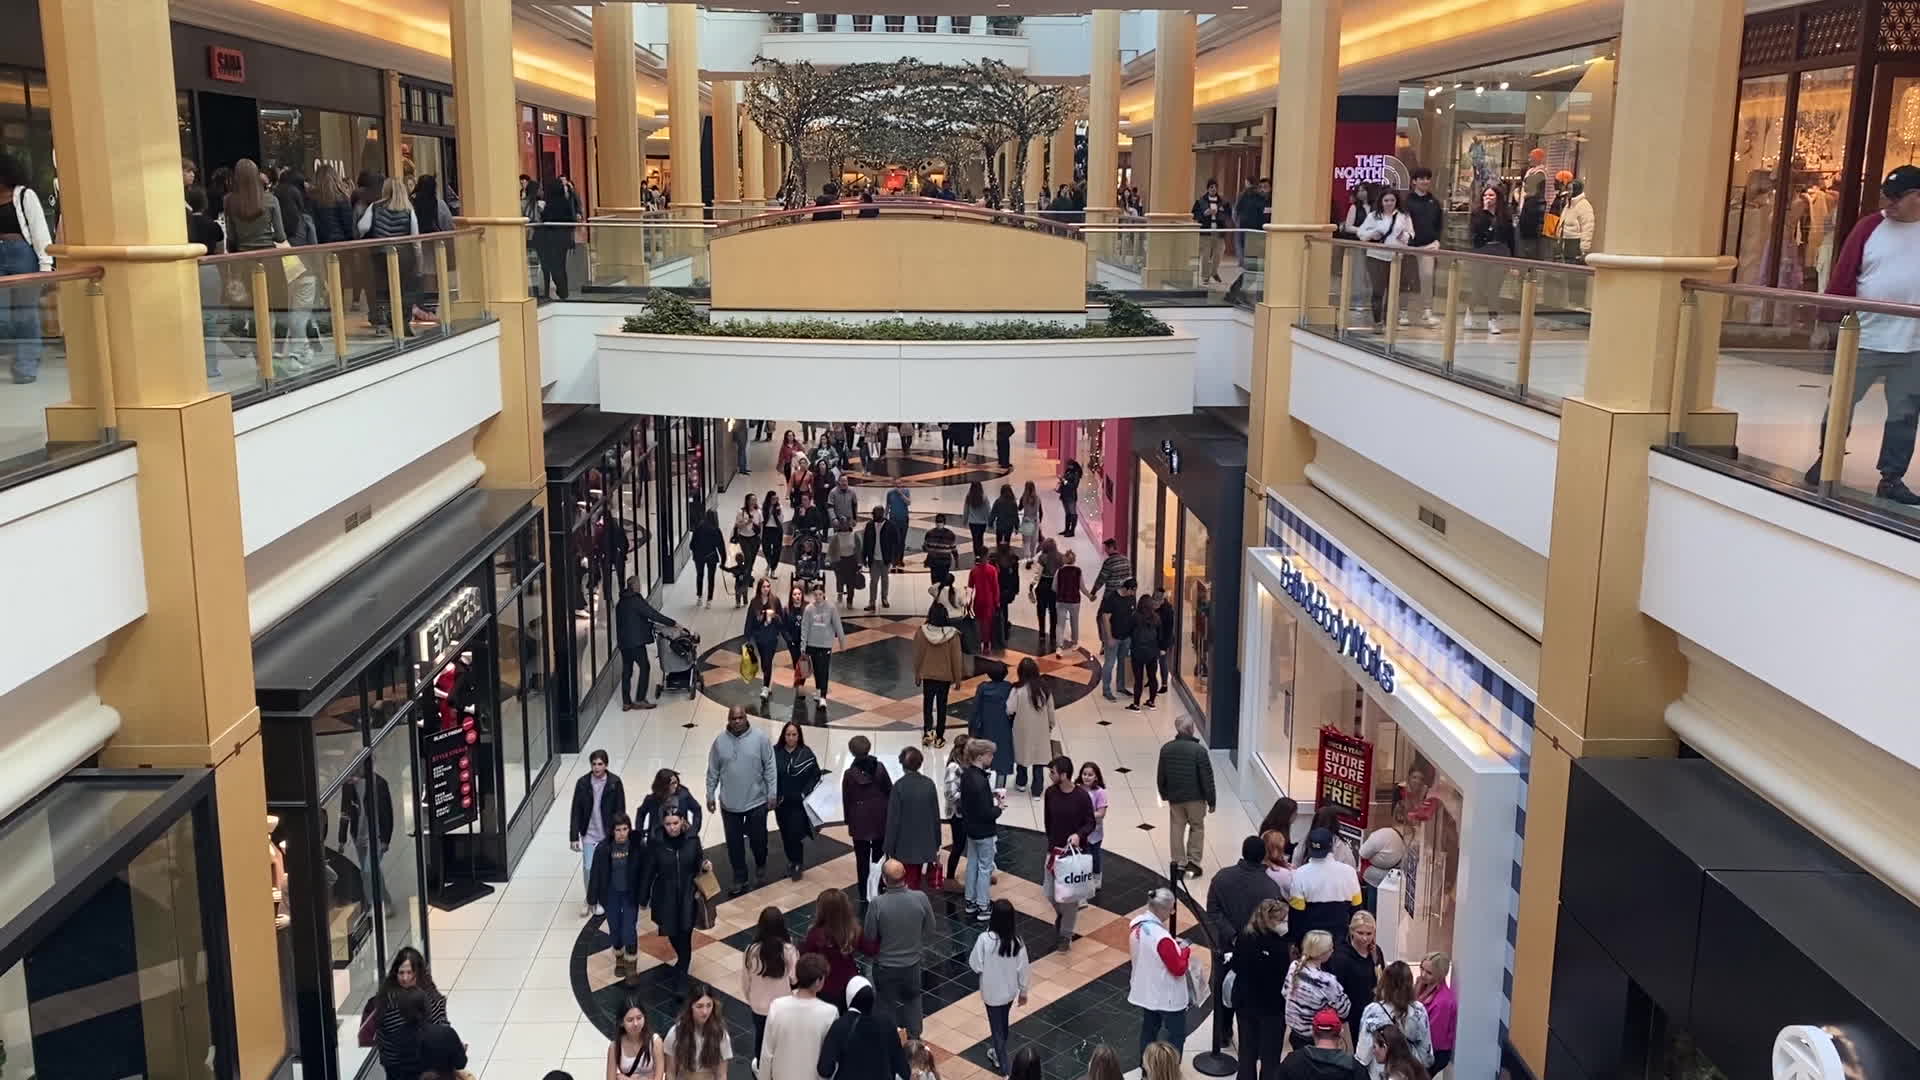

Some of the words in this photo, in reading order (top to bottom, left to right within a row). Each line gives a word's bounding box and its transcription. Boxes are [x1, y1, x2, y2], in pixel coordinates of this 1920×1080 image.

[1355, 154, 1383, 167] THE
[1334, 166, 1383, 179] NORTH
[1325, 749, 1365, 772] ENTIRE
[1324, 761, 1364, 783] STORE
[1322, 783, 1361, 808] FREE
[1064, 870, 1096, 885] claire
